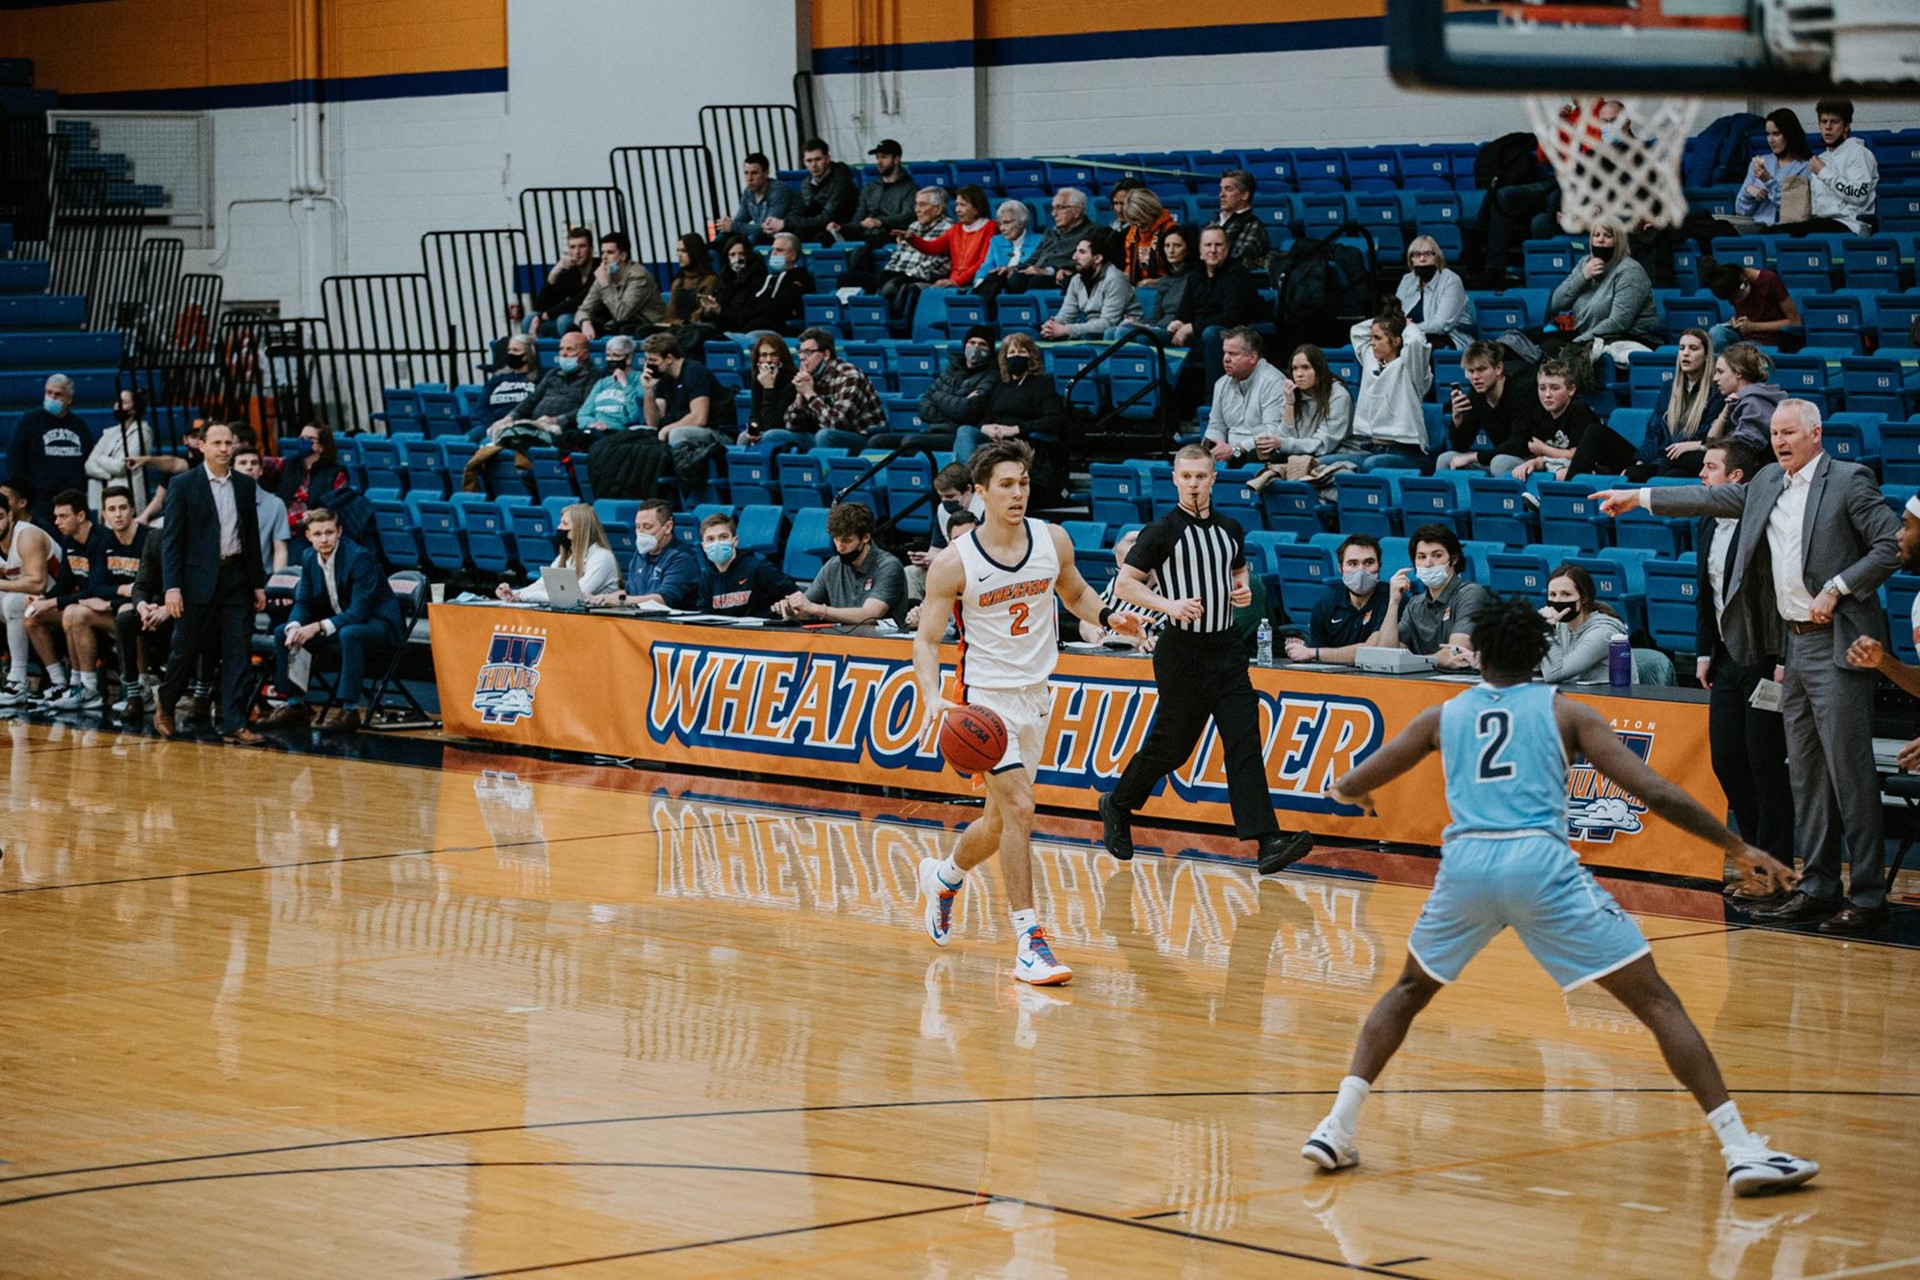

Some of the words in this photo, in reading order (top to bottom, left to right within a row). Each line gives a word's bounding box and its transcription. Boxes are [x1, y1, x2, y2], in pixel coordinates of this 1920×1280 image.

[978, 576, 1052, 608] WHEATON
[1009, 602, 1030, 636] 2
[1036, 679, 1375, 800] HUER
[1610, 718, 1656, 731] ATON
[1475, 707, 1517, 784] 2
